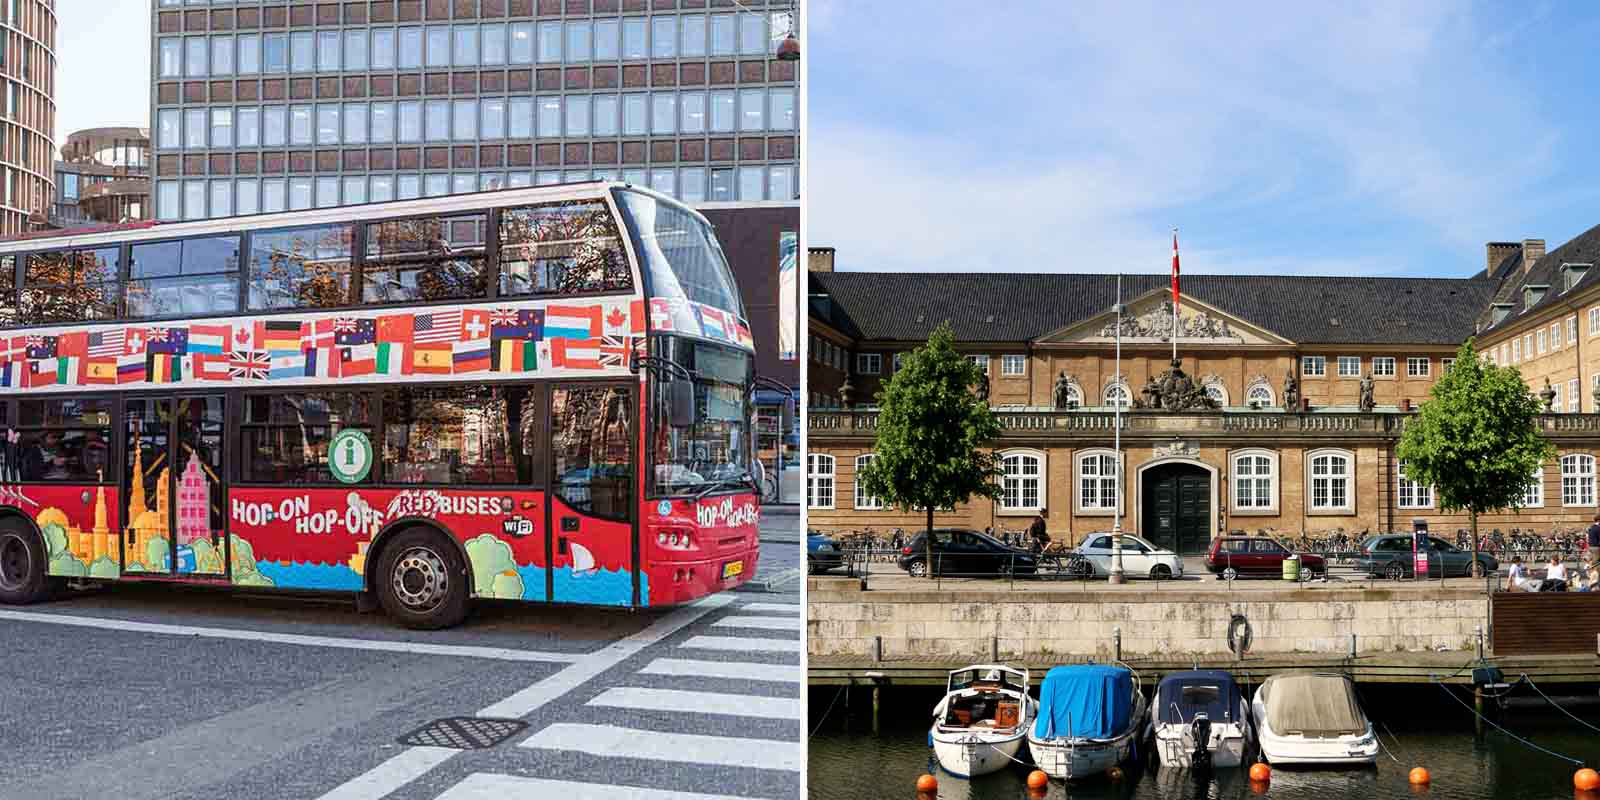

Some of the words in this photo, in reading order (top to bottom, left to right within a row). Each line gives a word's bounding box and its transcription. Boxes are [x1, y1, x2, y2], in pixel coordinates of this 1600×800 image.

[232, 495, 310, 526] HOP-ON
[296, 505, 384, 534] HOP-OFF
[400, 495, 434, 514] RED
[440, 496, 501, 515] BUSES
[696, 496, 733, 527] HOP-ON
